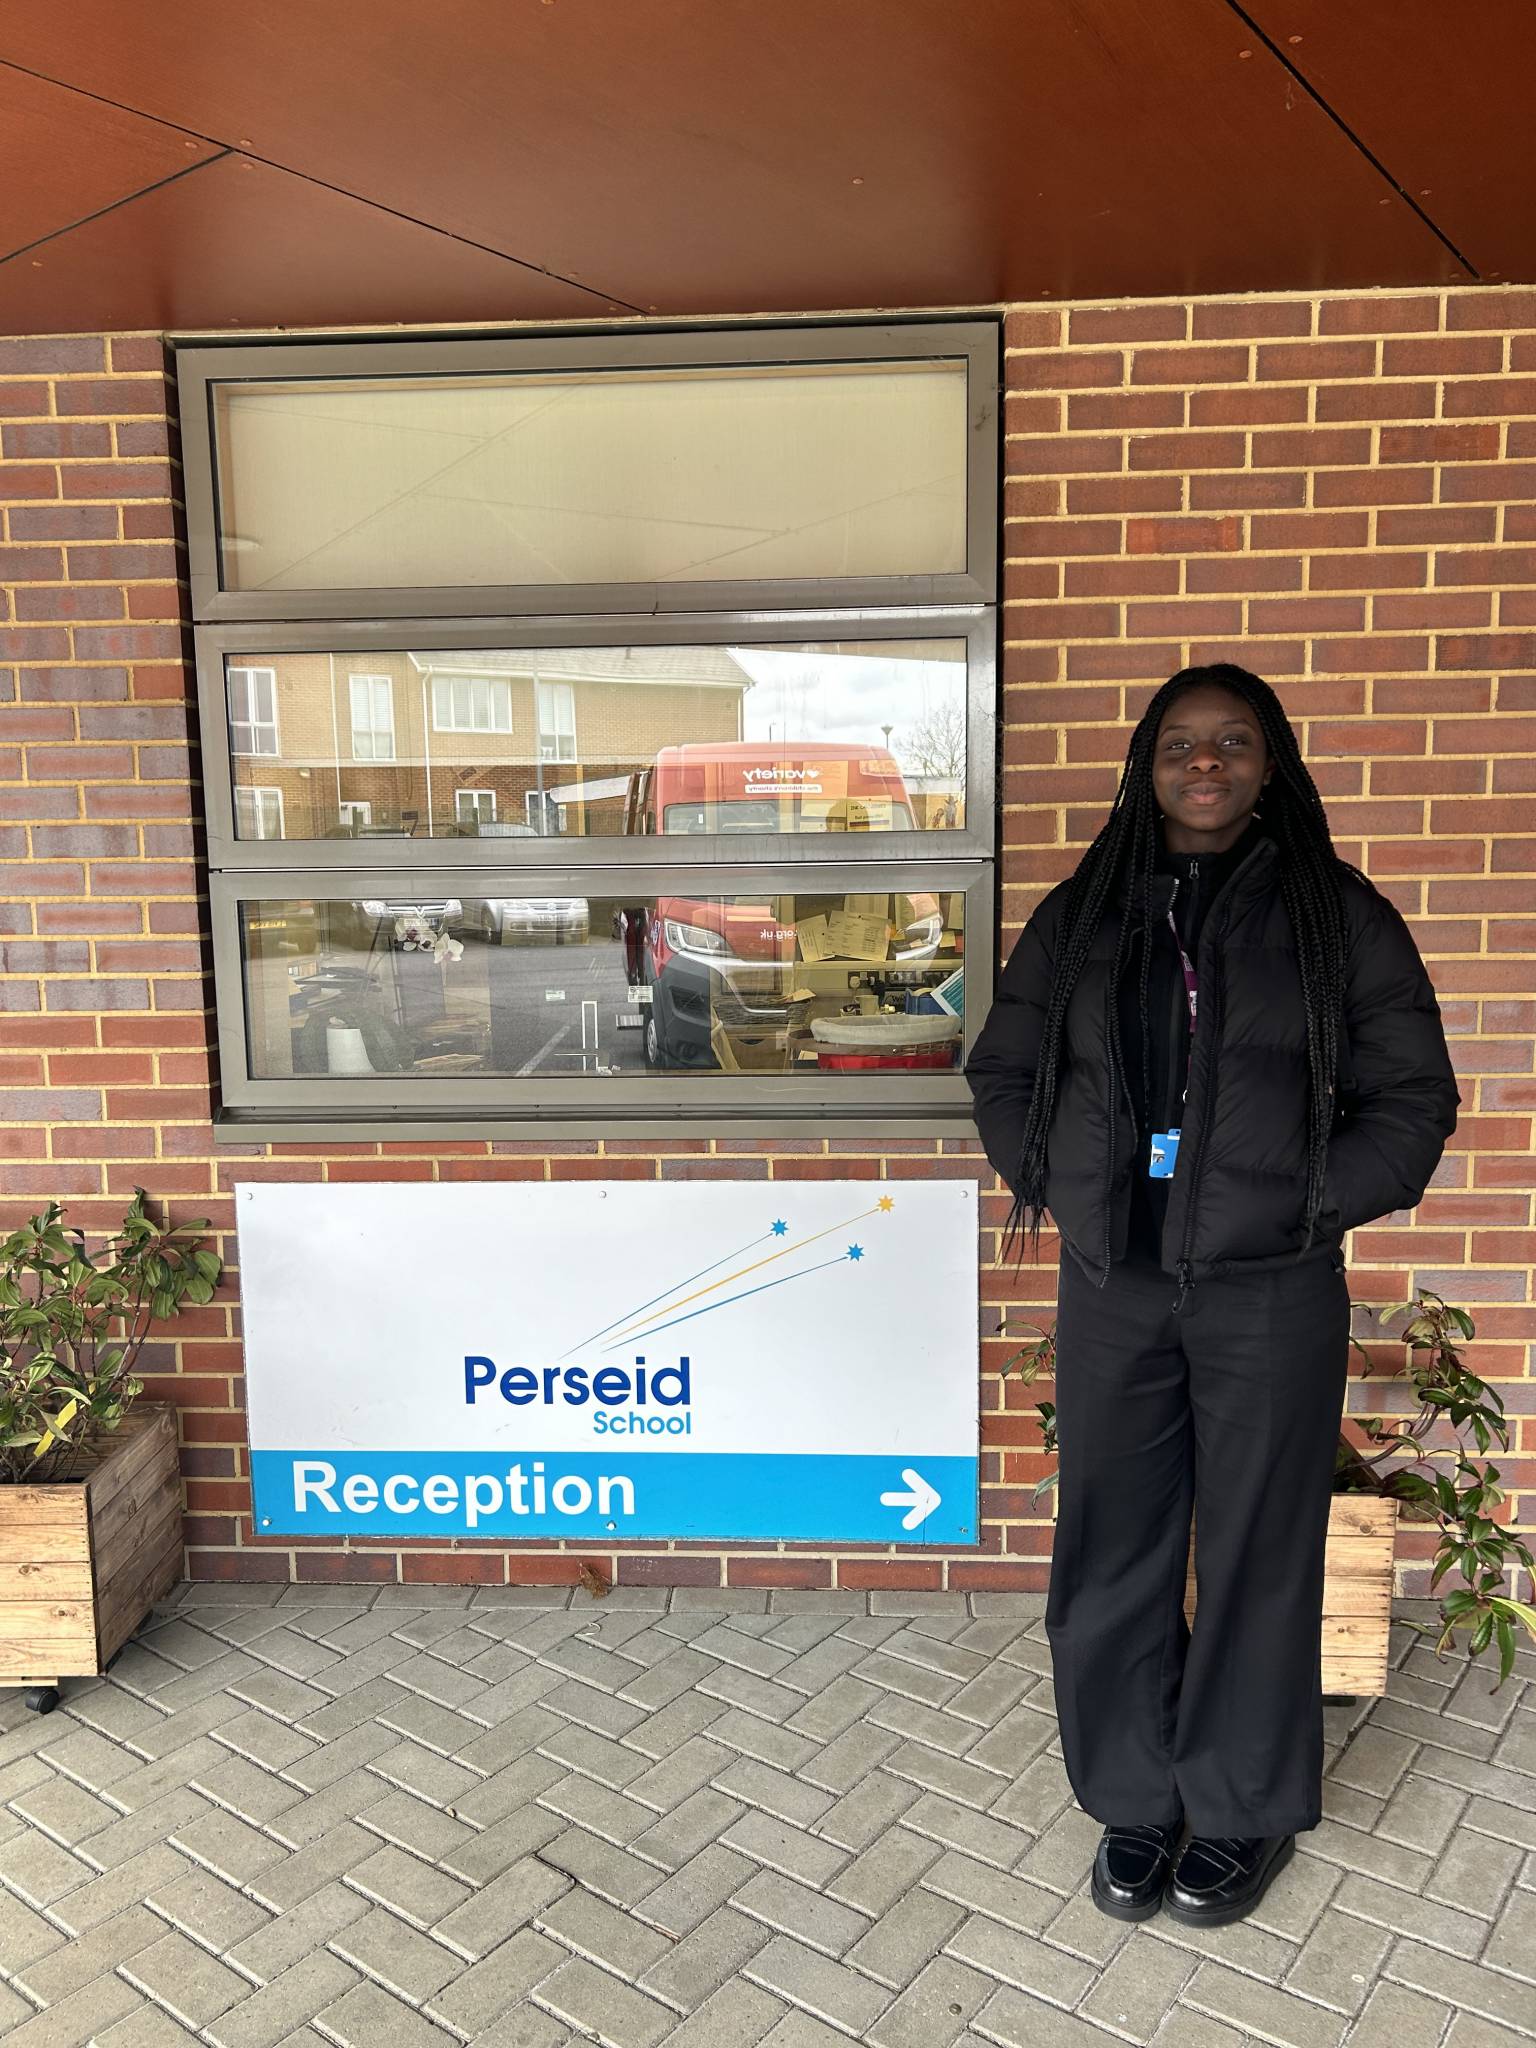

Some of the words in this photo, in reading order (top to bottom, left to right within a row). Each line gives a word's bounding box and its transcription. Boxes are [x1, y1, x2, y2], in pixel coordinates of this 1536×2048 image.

[464, 1356, 691, 1405] Perseid
[593, 1410, 691, 1435] School
[292, 1460, 635, 1528] Reception
